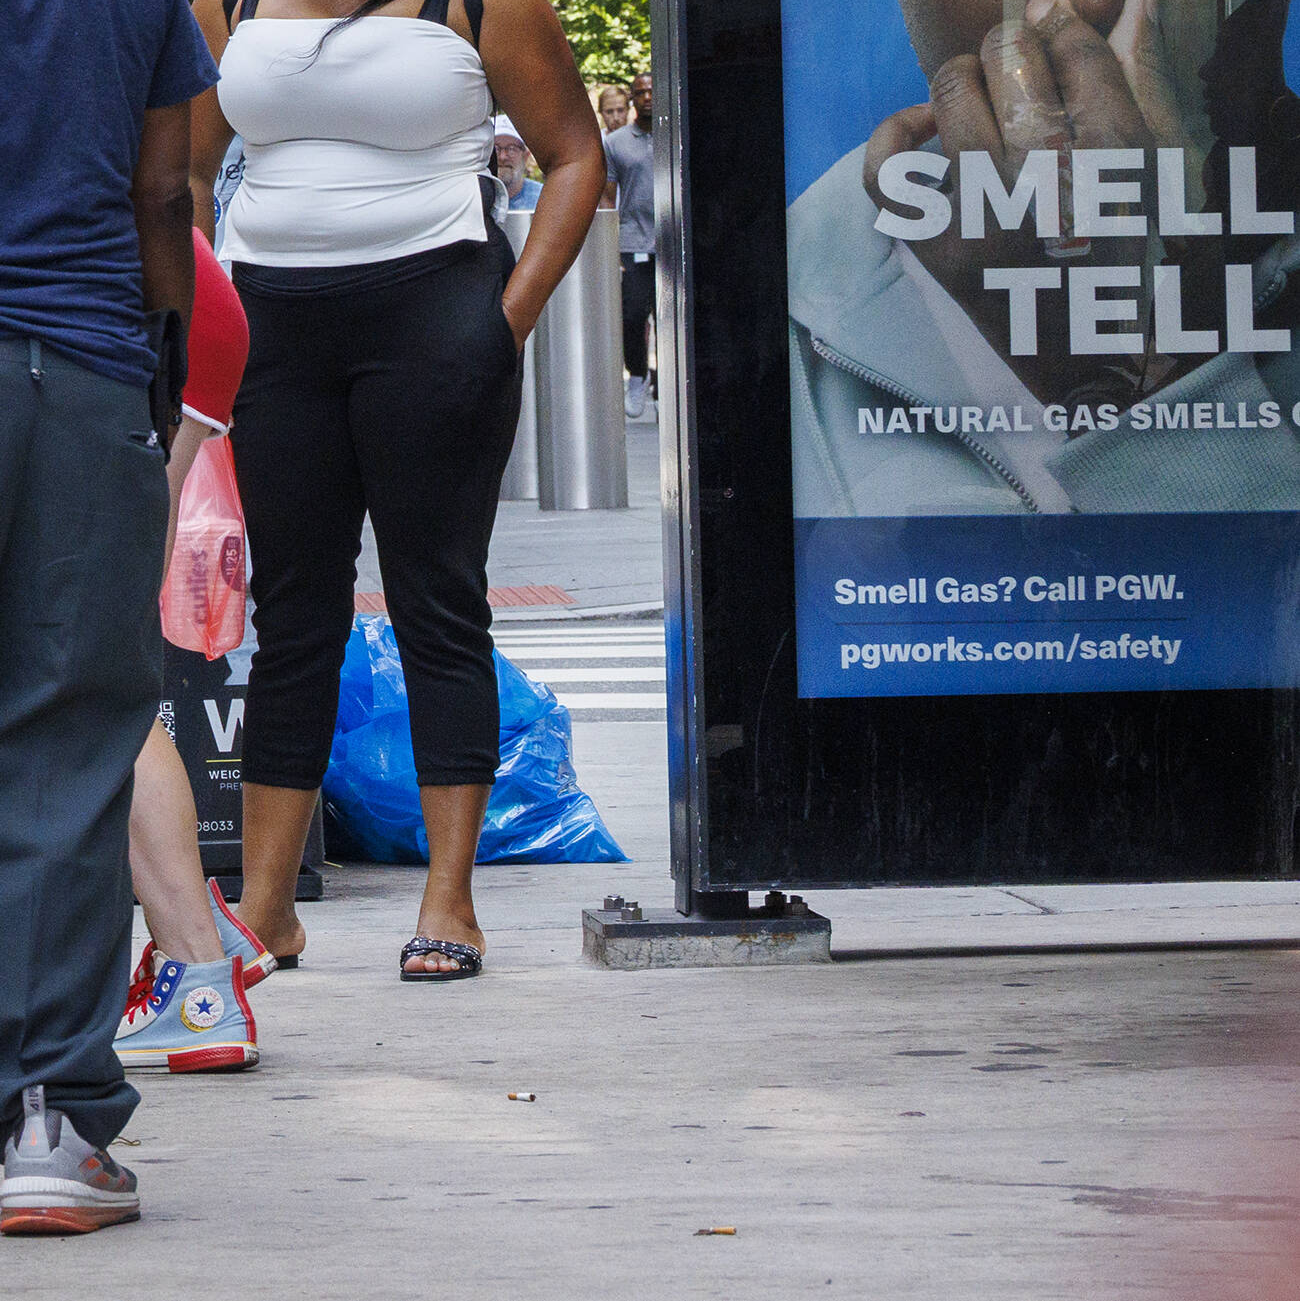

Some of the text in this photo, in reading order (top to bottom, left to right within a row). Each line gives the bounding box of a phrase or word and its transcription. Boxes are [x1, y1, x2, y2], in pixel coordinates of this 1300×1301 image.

[873, 146, 1295, 241] SMELL
[983, 264, 1291, 356] TELL
[858, 406, 1032, 434] NATURAL
[1042, 403, 1119, 431] GAS
[1130, 401, 1281, 430] SMELLS
[834, 574, 1184, 605] Smell Gas? Call PGW.
[841, 633, 1182, 670] pgworks.com/safety
